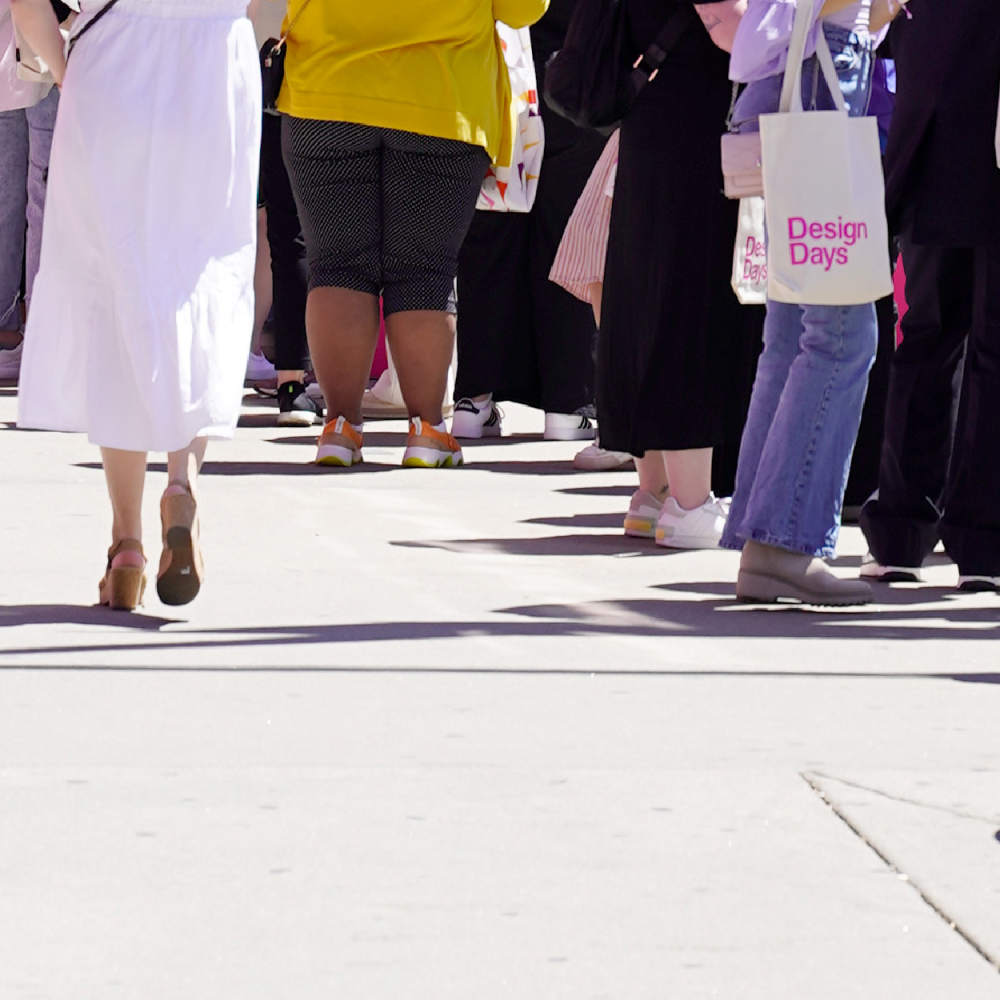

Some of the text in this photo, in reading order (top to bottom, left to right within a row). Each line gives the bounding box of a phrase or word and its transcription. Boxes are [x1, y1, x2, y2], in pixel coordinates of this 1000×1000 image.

[787, 216, 868, 246] Design
[743, 259, 768, 285] Days
[789, 242, 848, 272] Days
